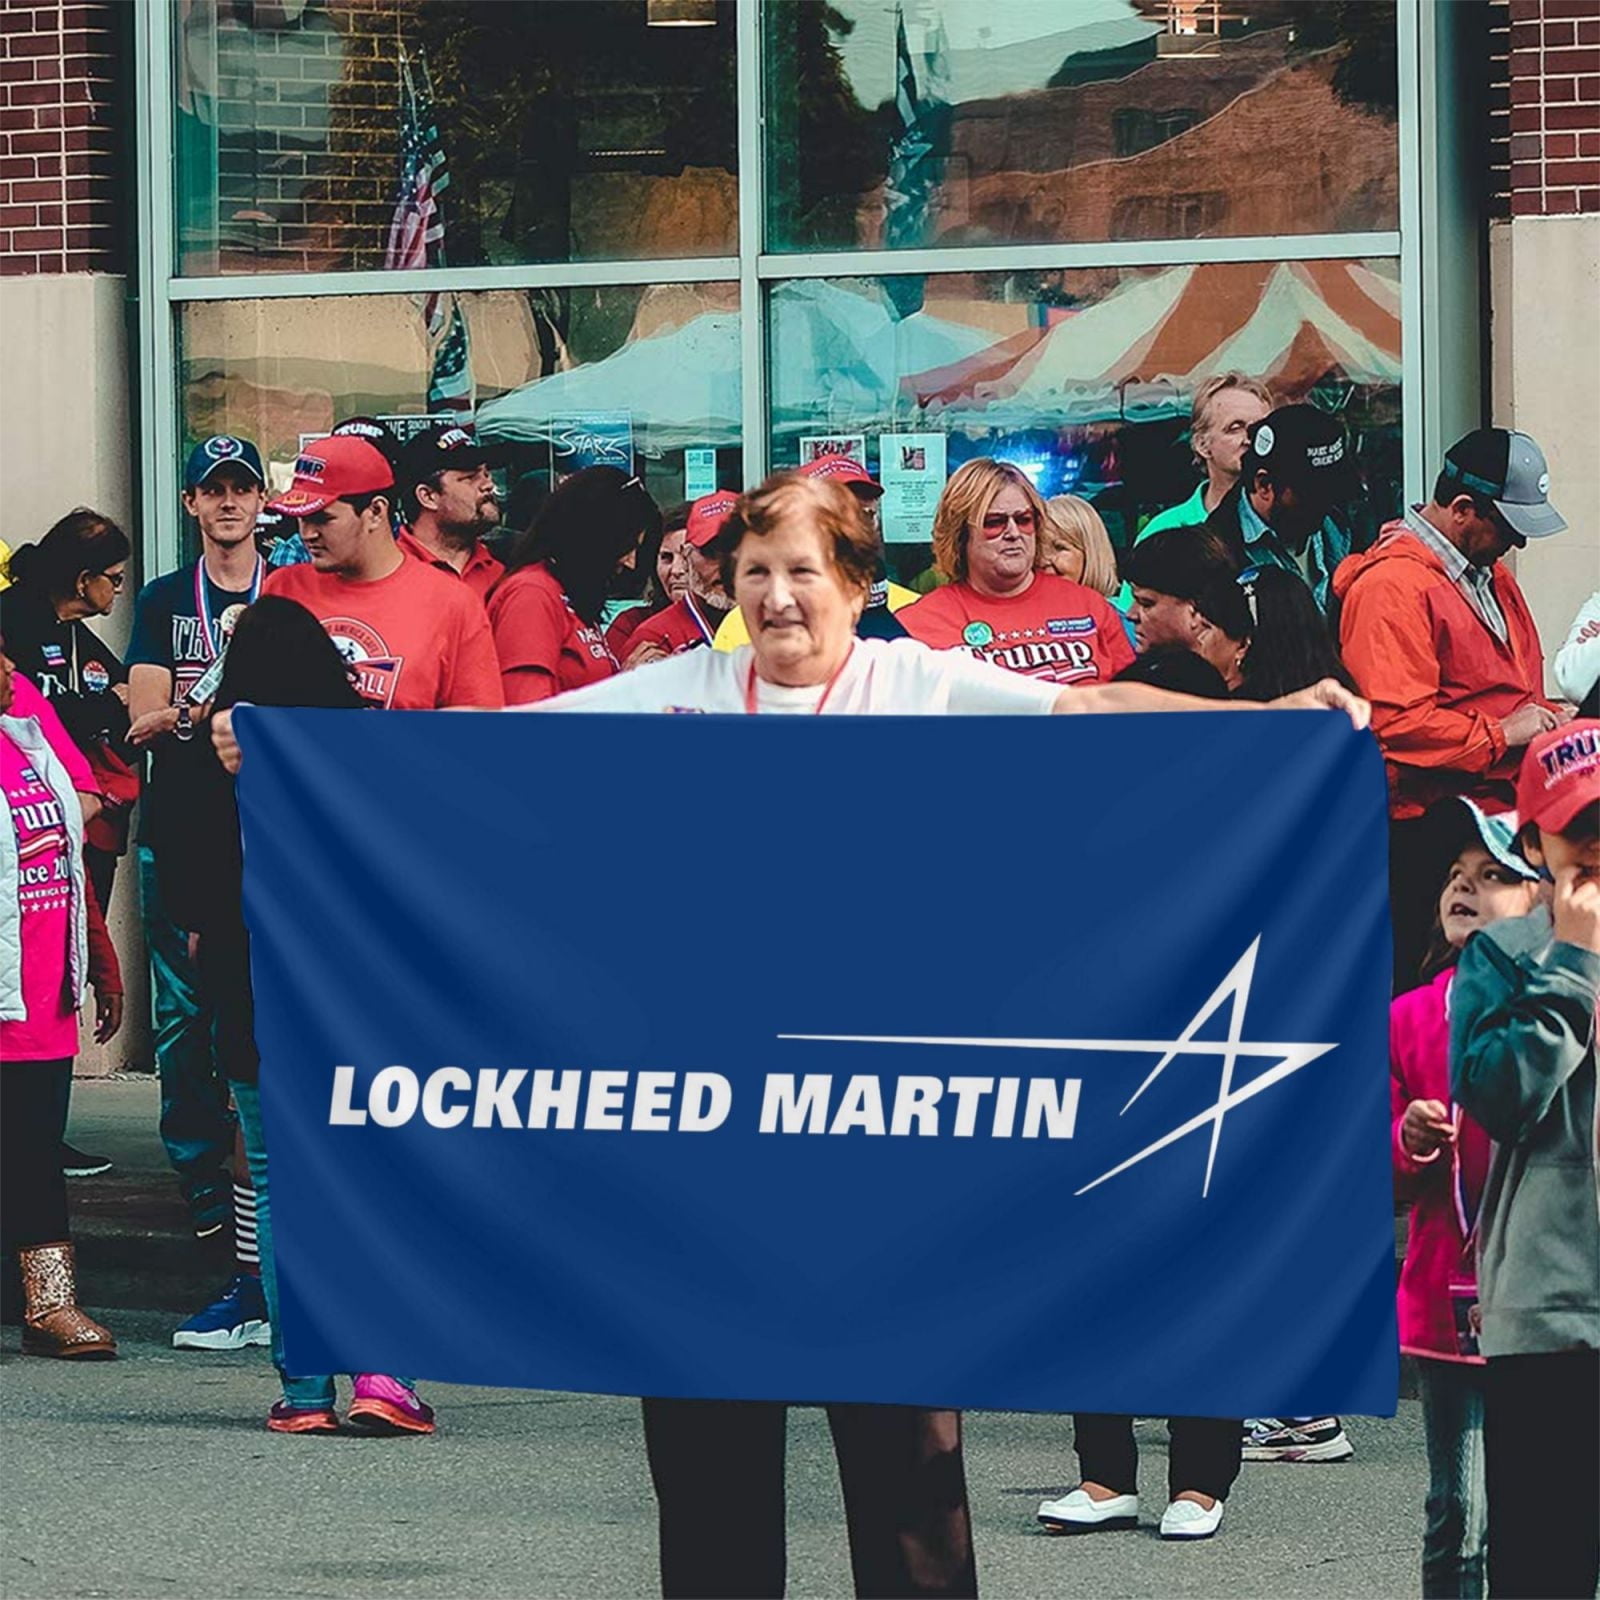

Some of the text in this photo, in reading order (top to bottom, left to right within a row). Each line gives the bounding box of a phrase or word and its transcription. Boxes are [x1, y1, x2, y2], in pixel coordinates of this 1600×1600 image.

[555, 429, 629, 461] STARZ
[329, 1065, 1082, 1139] LOCKHEED MARTIN
